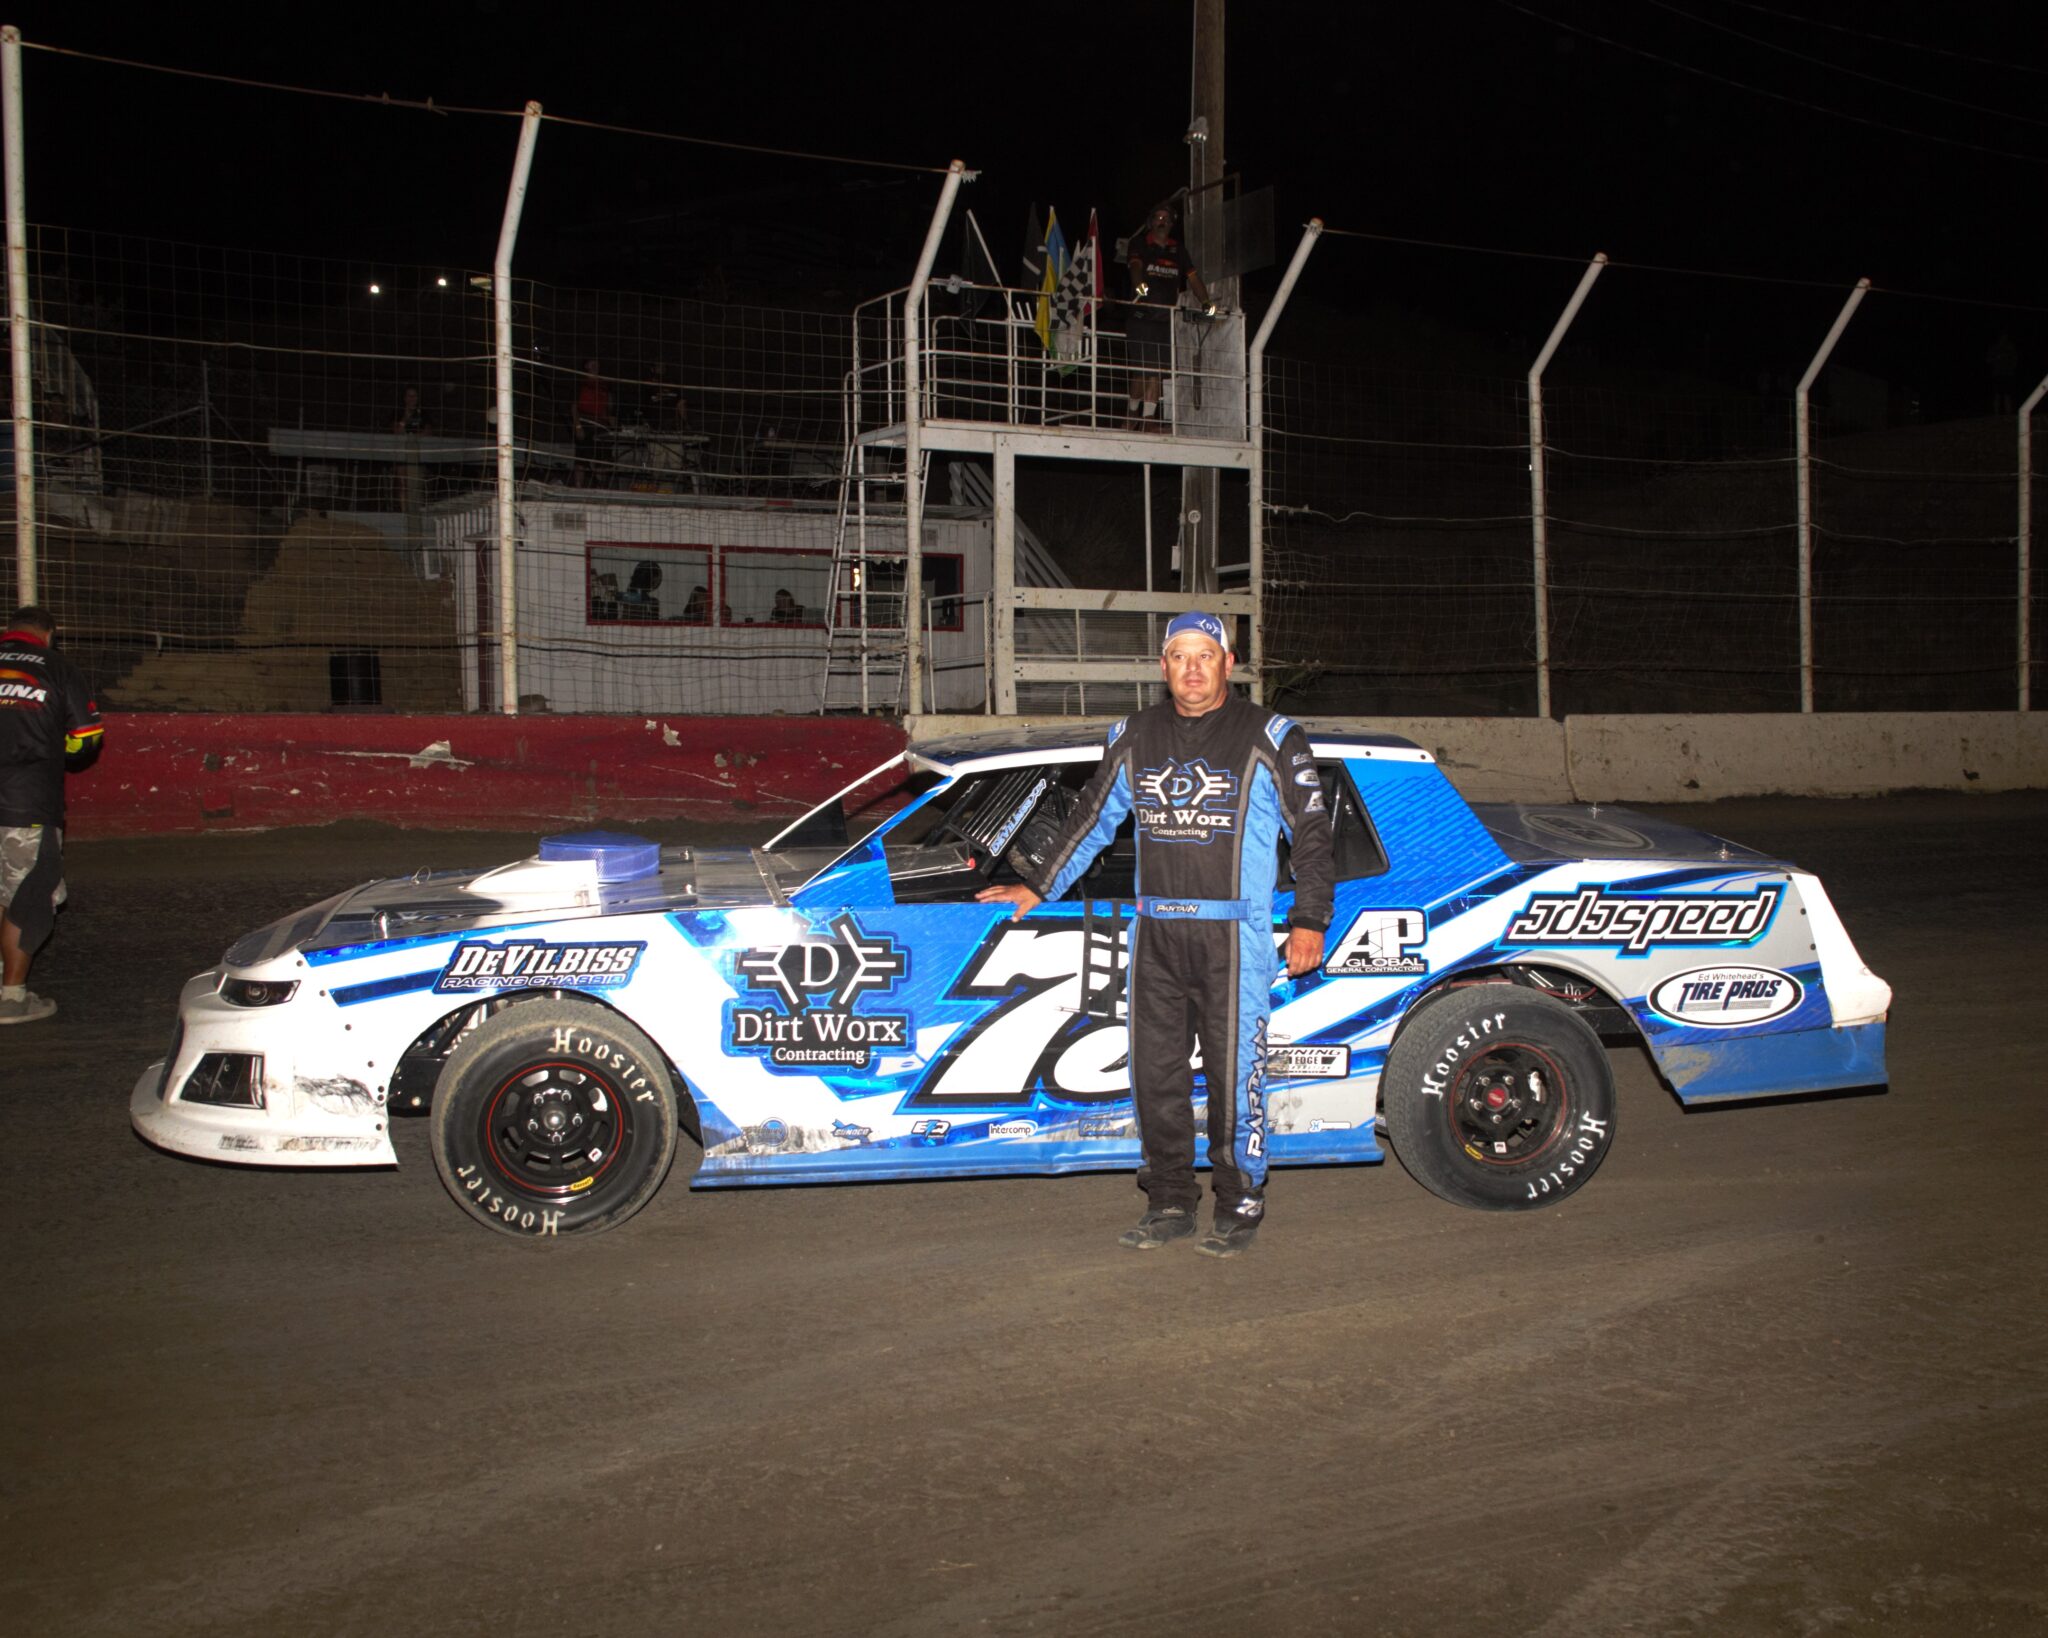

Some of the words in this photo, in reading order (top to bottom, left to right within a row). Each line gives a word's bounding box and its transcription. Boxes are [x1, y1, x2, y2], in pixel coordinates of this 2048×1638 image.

[1172, 778, 1192, 796] D
[1138, 807, 1168, 825] Dirt
[1173, 809, 1232, 827] Worx
[1151, 826, 1208, 838] Contracting
[1326, 909, 1424, 968] AP
[801, 941, 840, 987] D
[1346, 957, 1424, 968] GLOBAL
[1365, 965, 1424, 973] CONTRACTORS
[442, 976, 526, 989] RACING
[529, 973, 626, 986] CHASSIS
[1712, 973, 1764, 981] Whitehead's
[1676, 981, 1725, 1013] TIRE
[1722, 979, 1782, 1011] PROS
[737, 1013, 804, 1042] Dirt
[811, 1013, 901, 1042] Worx
[775, 1047, 865, 1063] Contracting
[1294, 1056, 1319, 1065] EDGE
[1421, 1012, 1506, 1100] Hoosier
[548, 1027, 655, 1103] Hoosier
[990, 1124, 1031, 1135] Intercomp
[1526, 1110, 1608, 1200] Hoosier
[456, 1164, 566, 1236] Hoosier
